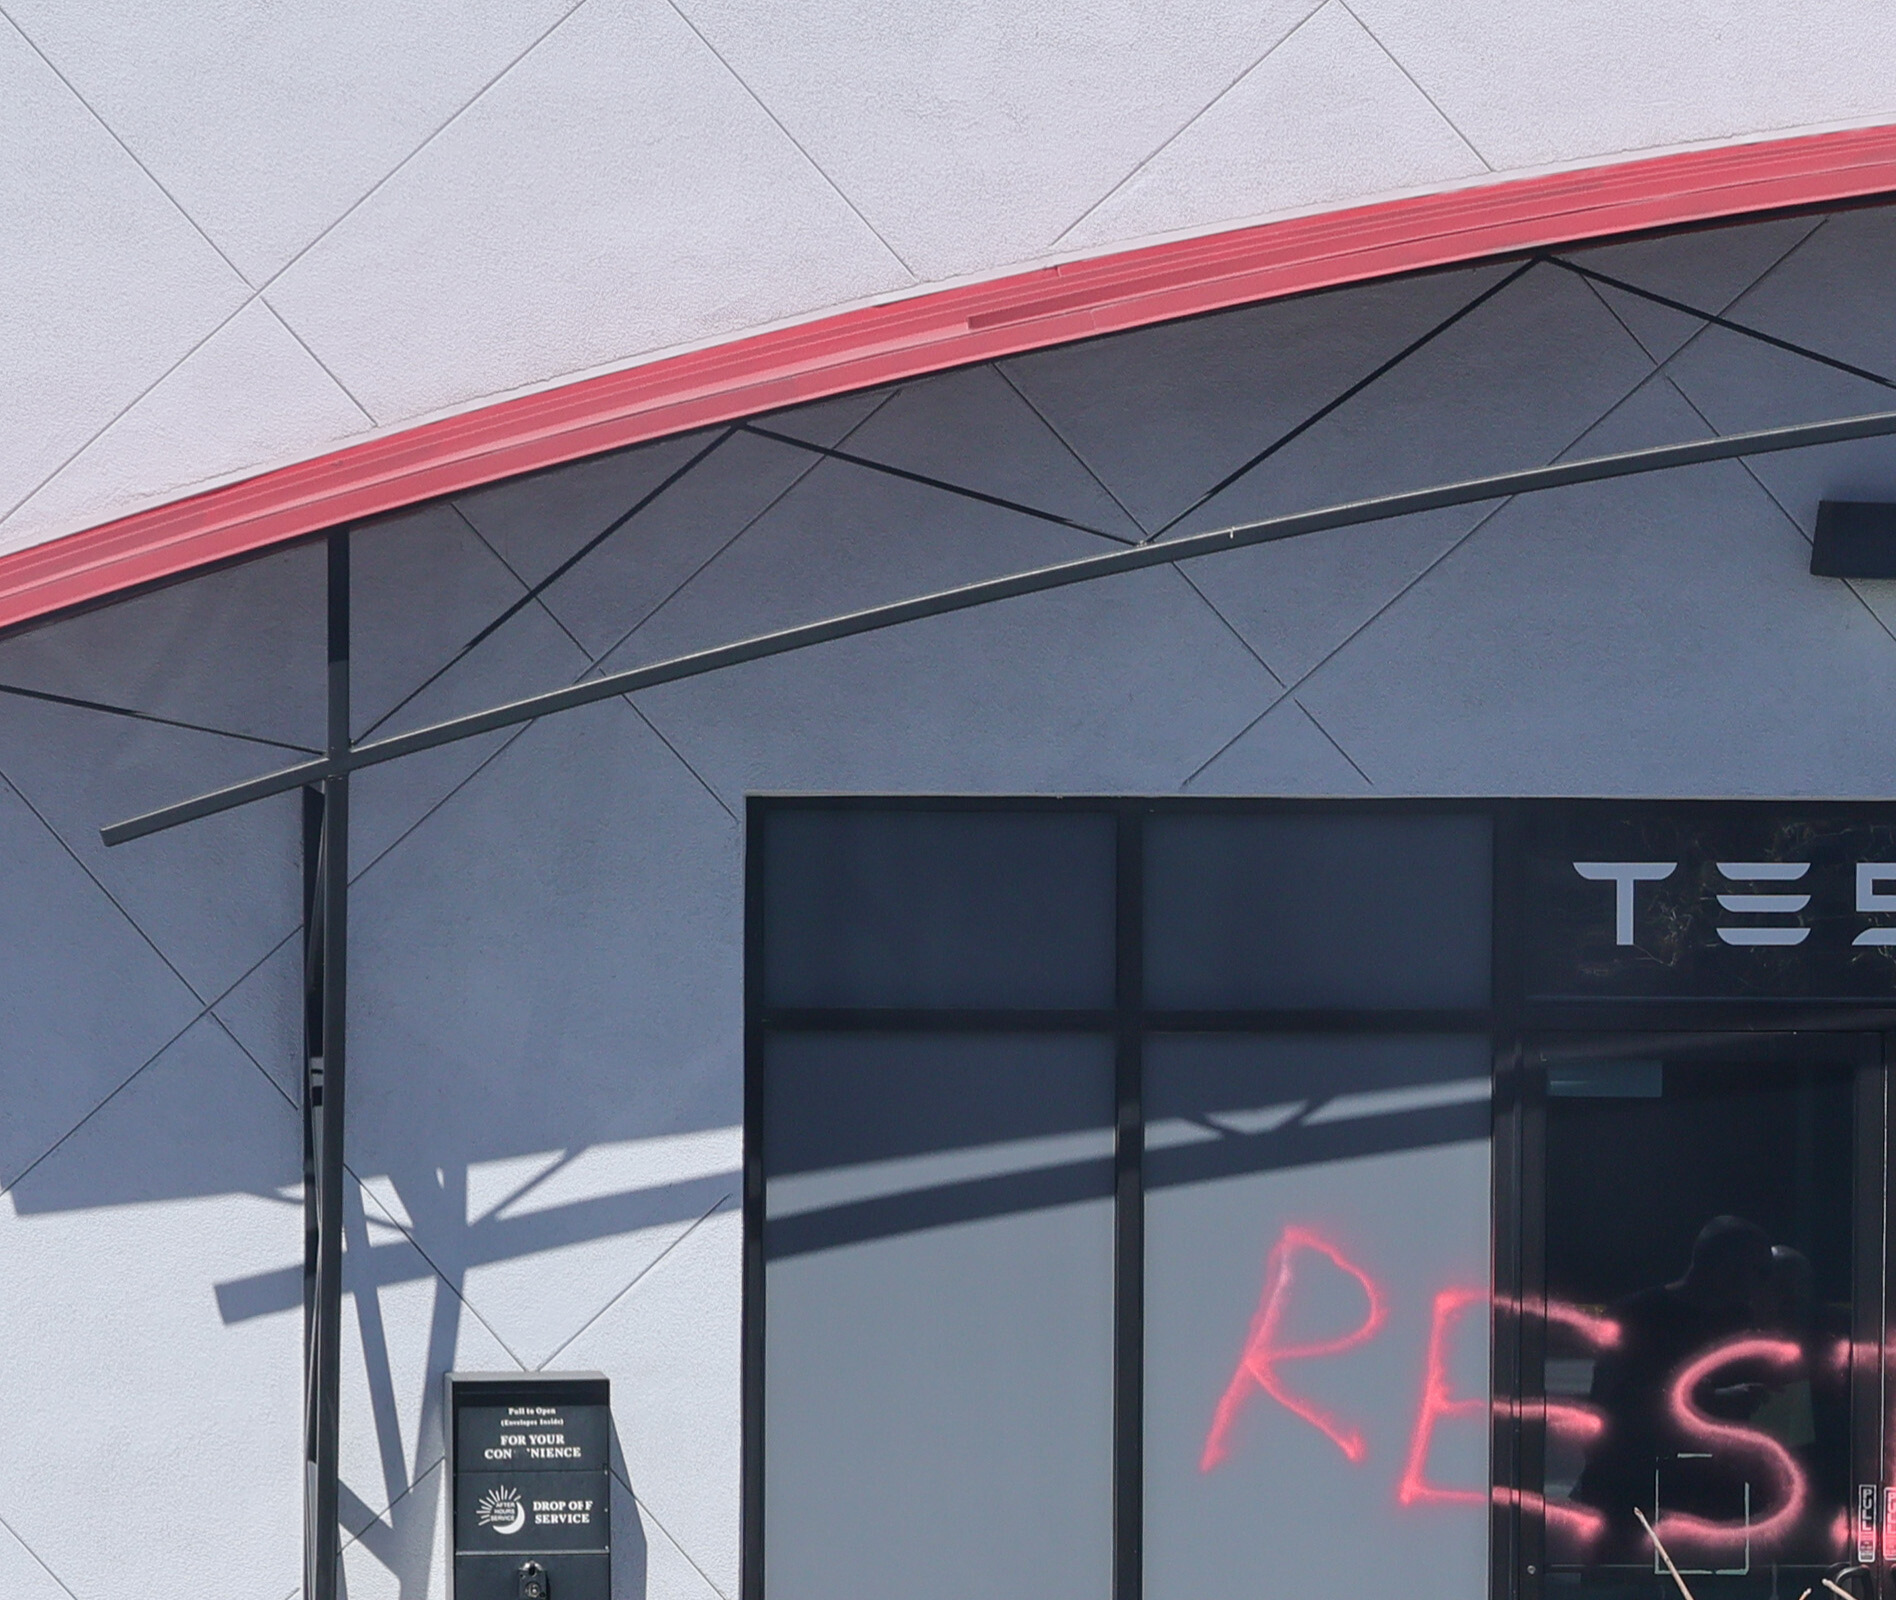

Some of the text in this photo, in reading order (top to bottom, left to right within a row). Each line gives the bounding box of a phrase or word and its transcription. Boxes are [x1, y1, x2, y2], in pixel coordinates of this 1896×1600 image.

[508, 1407, 525, 1415] Pull
[536, 1407, 556, 1416] Open
[500, 1434, 565, 1446] FOR YOUR
[484, 1447, 581, 1459] CONNIENCE
[533, 1501, 593, 1511] DROP OFF
[1862, 1488, 1872, 1531] PULL
[535, 1514, 590, 1524] SERVICE
[1887, 1492, 1896, 1534] PULL
